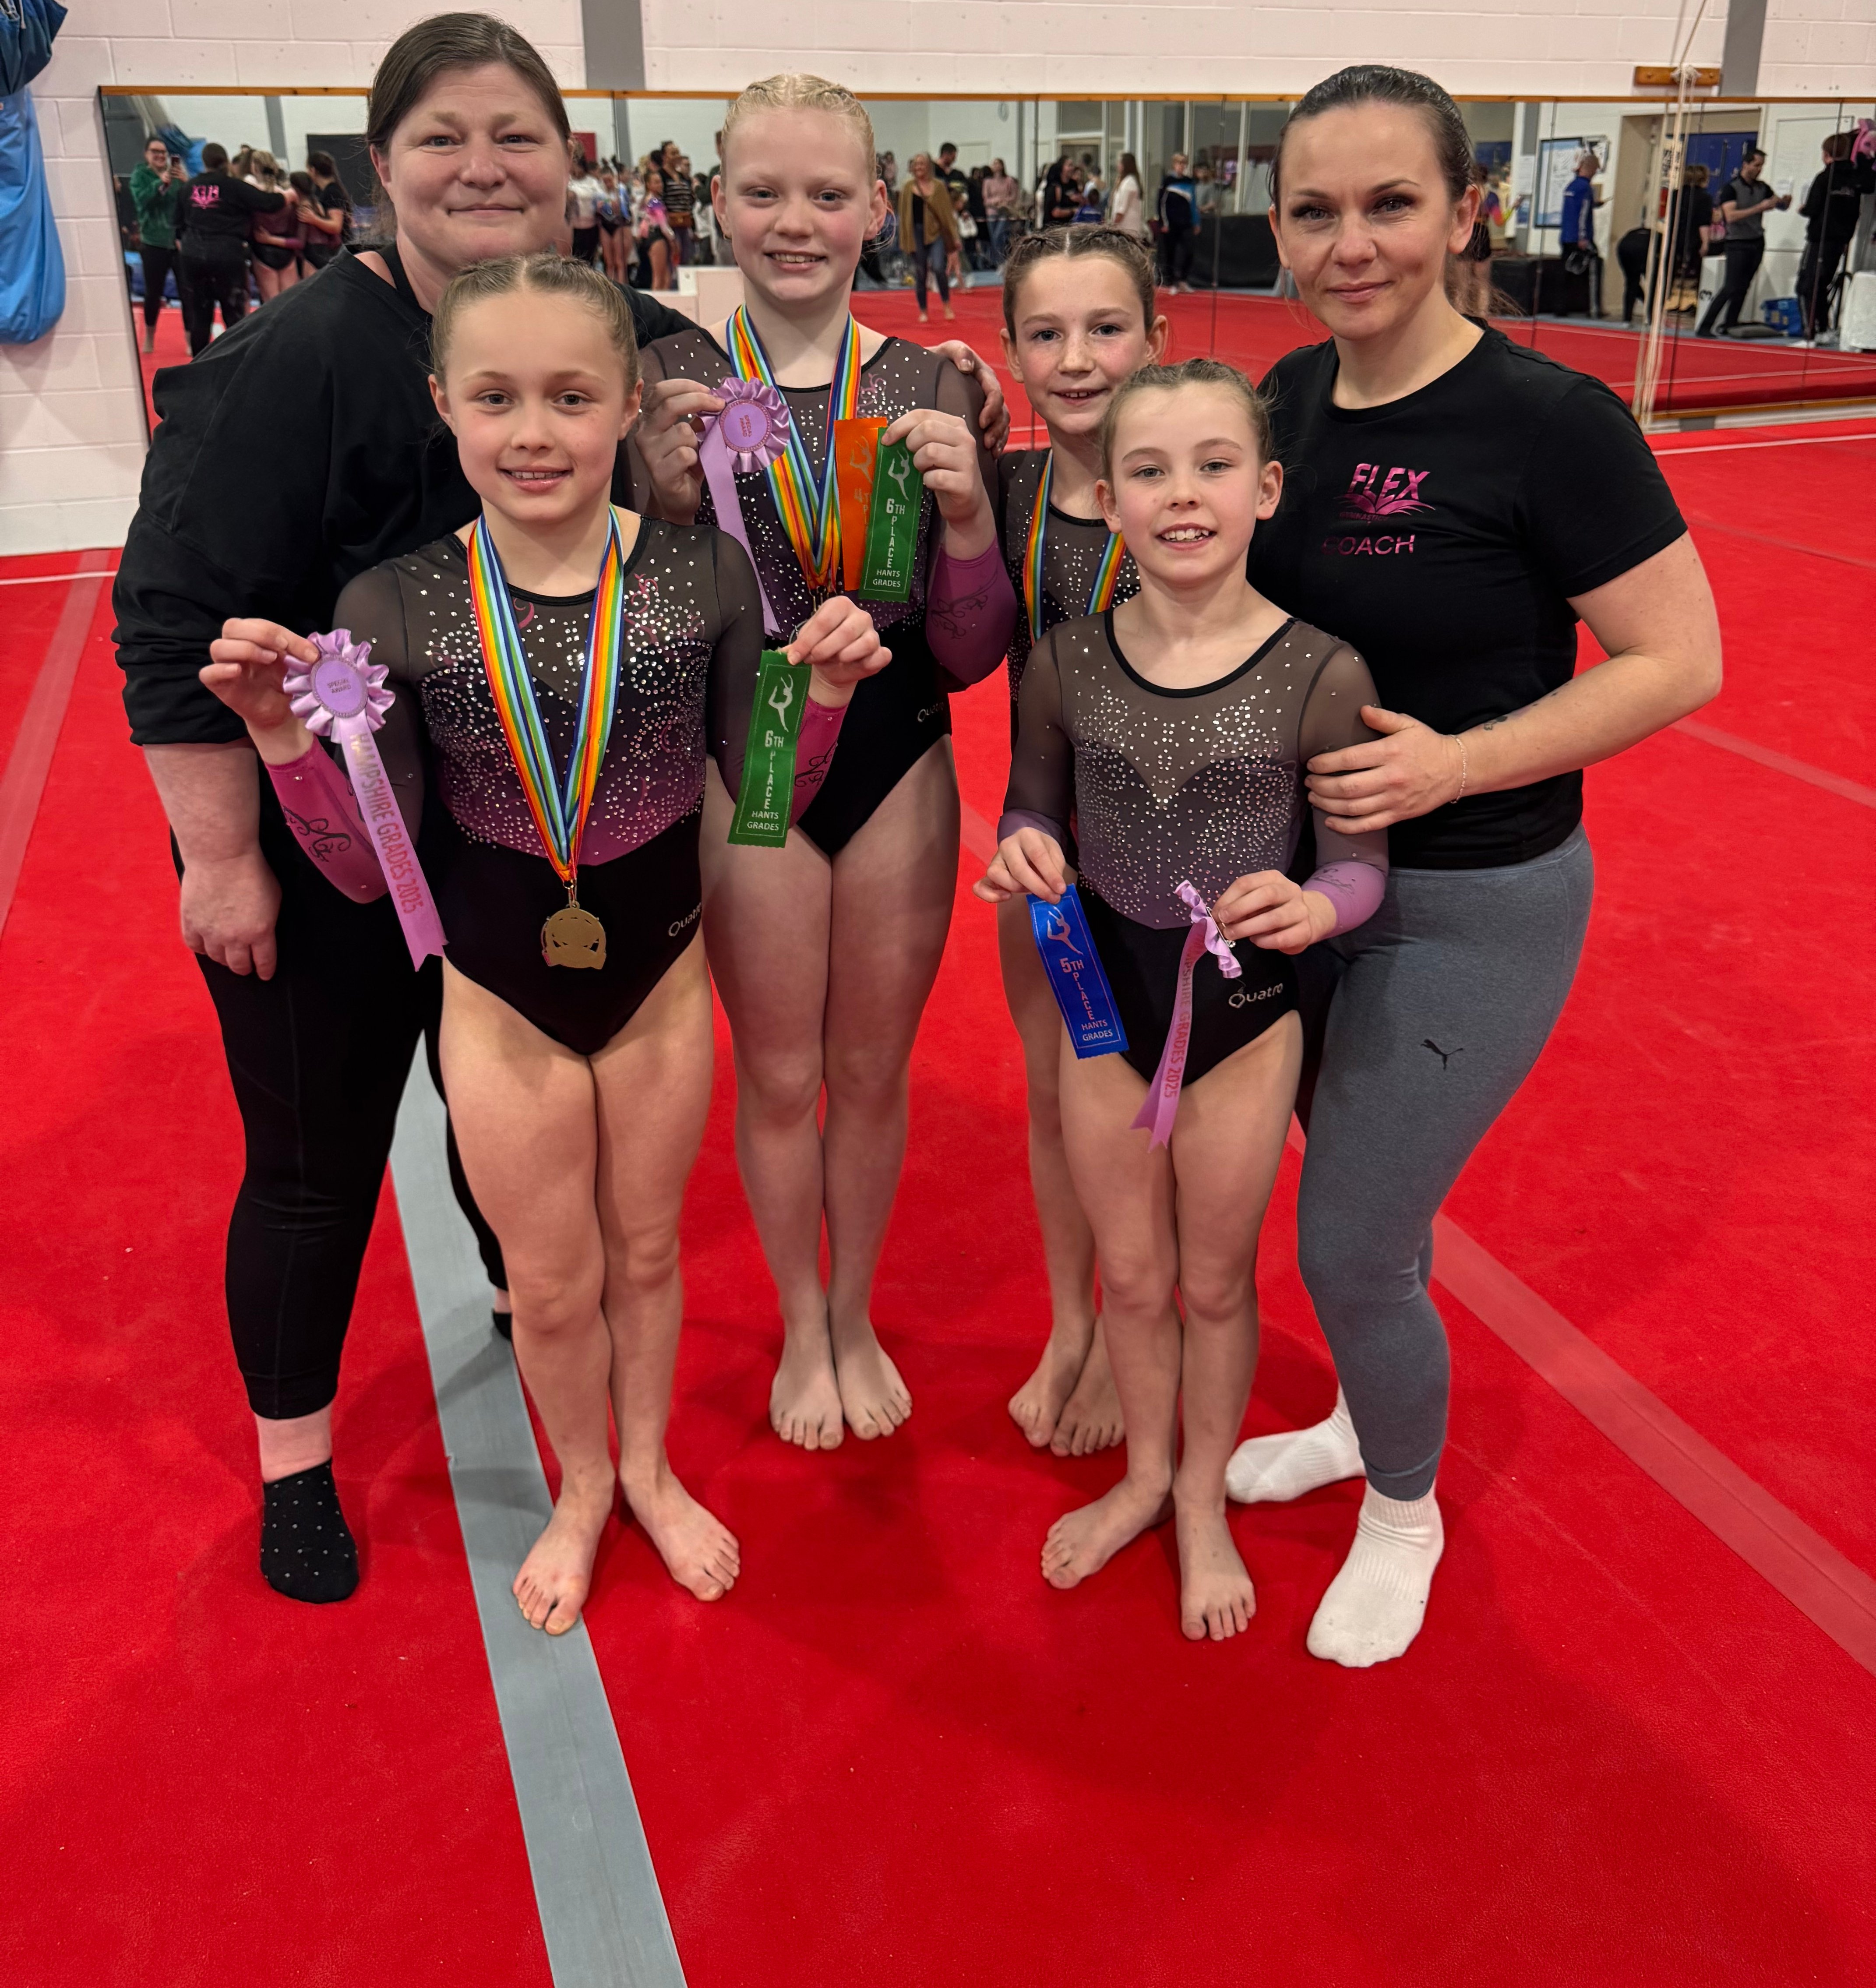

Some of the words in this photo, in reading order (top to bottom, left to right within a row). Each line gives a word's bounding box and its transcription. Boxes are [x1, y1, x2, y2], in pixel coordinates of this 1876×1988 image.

[1347, 463, 1431, 506] FLEX
[886, 498, 905, 515] 6TH
[887, 516, 897, 568] PLACE
[1322, 534, 1415, 555] COACH
[873, 578, 901, 588] GRADES
[765, 730, 784, 747] 6TH
[764, 750, 776, 809] PLACE
[350, 733, 395, 822] HAMPSHIRE
[377, 822, 414, 880] GRADES
[396, 878, 423, 914] 2025
[751, 811, 779, 819] HANTS
[747, 821, 779, 831] GRADES
[1059, 957, 1085, 973] 5TH
[1073, 972, 1094, 1020] PLACE
[1228, 983, 1284, 1009] Quatro
[1081, 1019, 1108, 1030] HANTS
[1083, 1029, 1113, 1041] GRADES
[1171, 1011, 1190, 1065] GRADES
[1164, 1067, 1181, 1098] 2025
